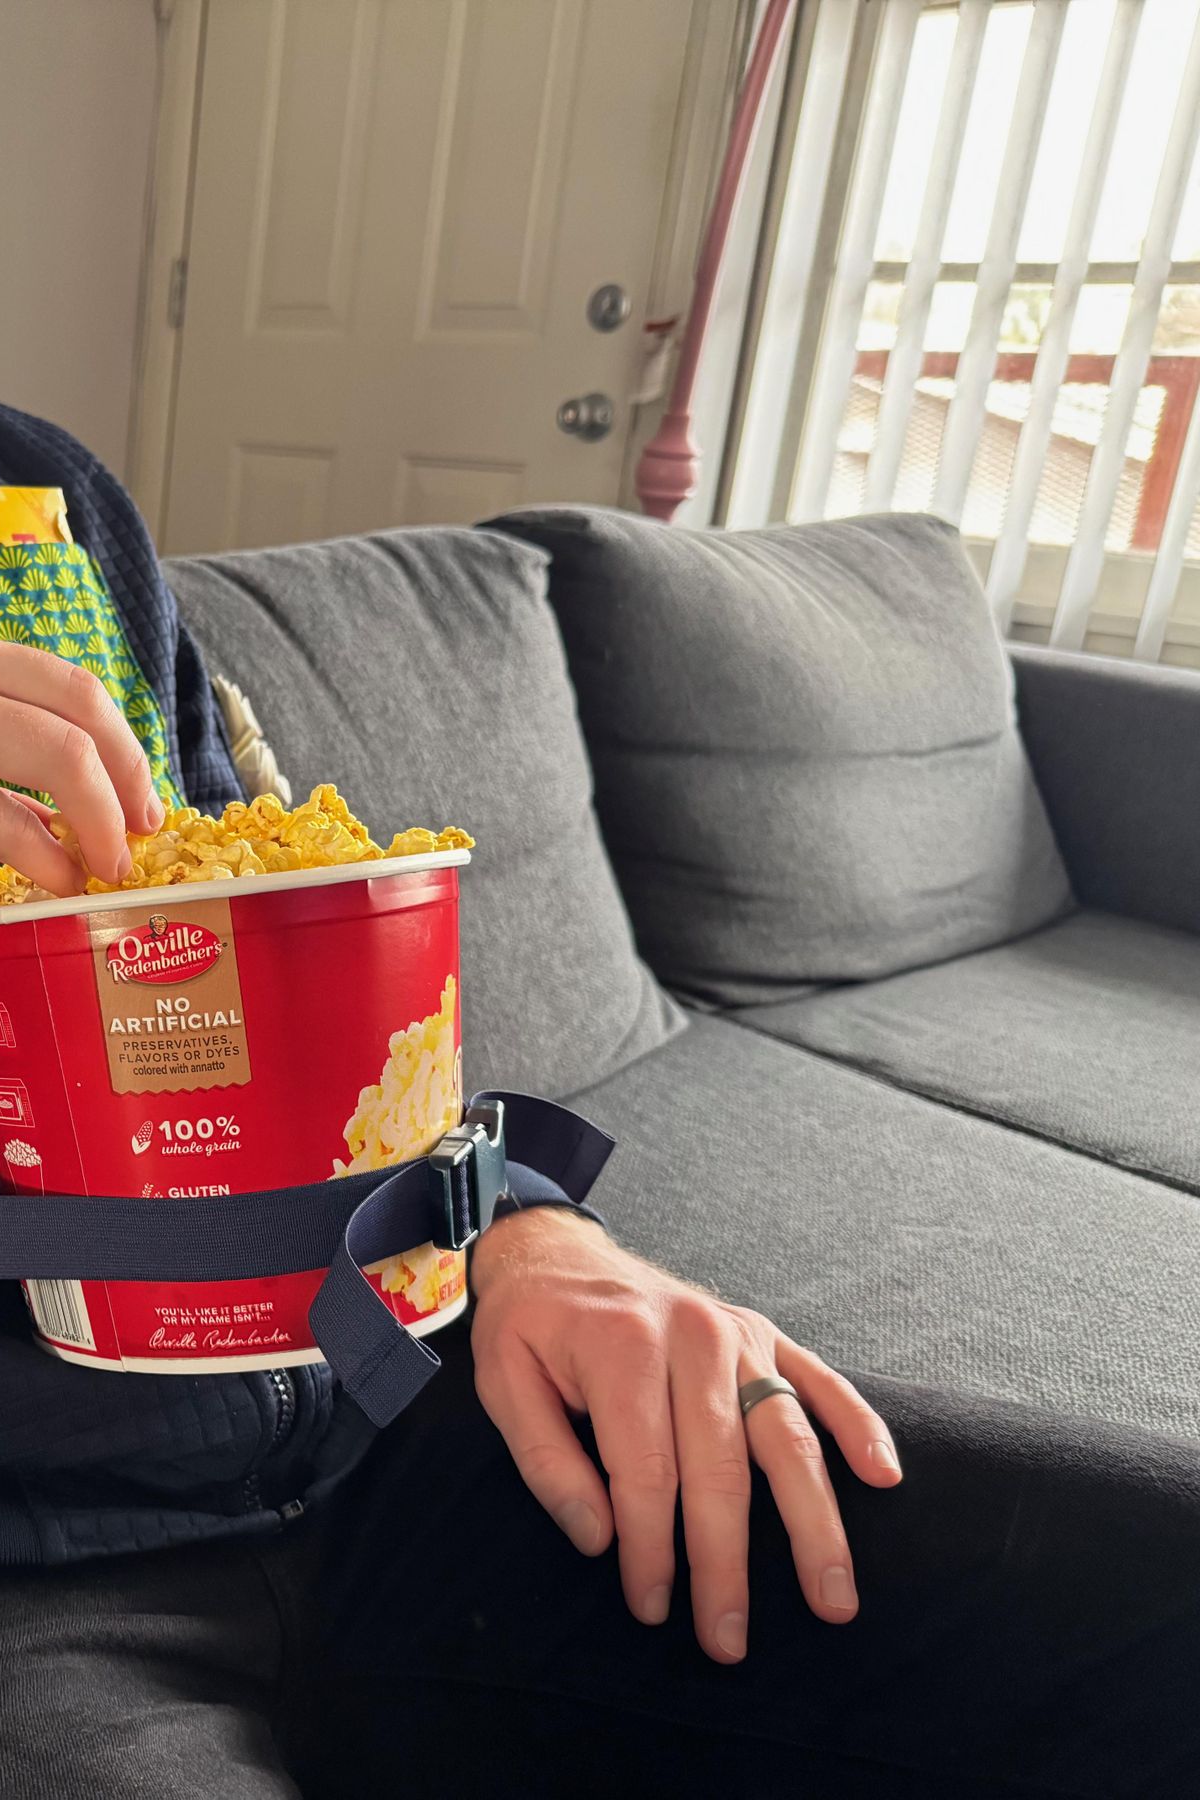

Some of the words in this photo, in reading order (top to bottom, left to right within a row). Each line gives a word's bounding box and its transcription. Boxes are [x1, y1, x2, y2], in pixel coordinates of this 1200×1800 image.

[118, 927, 203, 961] Orville
[107, 941, 222, 981] Redenbacher's
[156, 997, 190, 1014] NO
[110, 1009, 241, 1033] ARTIFICIAL
[123, 1034, 233, 1051] PRESERVATIVES,
[119, 1052, 179, 1063] FLAVORS
[183, 1051, 200, 1060] OR
[206, 1046, 240, 1059] DYES
[133, 1065, 168, 1076] colored
[169, 1063, 189, 1074] with
[191, 1061, 225, 1073] annatto
[159, 1115, 240, 1141] 100%
[161, 1141, 203, 1155] whole
[205, 1139, 241, 1157] grain
[168, 1184, 230, 1198] GLUTEN
[155, 1307, 192, 1316] YOU'LL
[195, 1306, 218, 1316] LIKE
[220, 1306, 230, 1315] IT
[233, 1302, 273, 1314] BETTER
[163, 1316, 178, 1325] OR
[181, 1316, 196, 1325] MY
[200, 1314, 231, 1325] NAME
